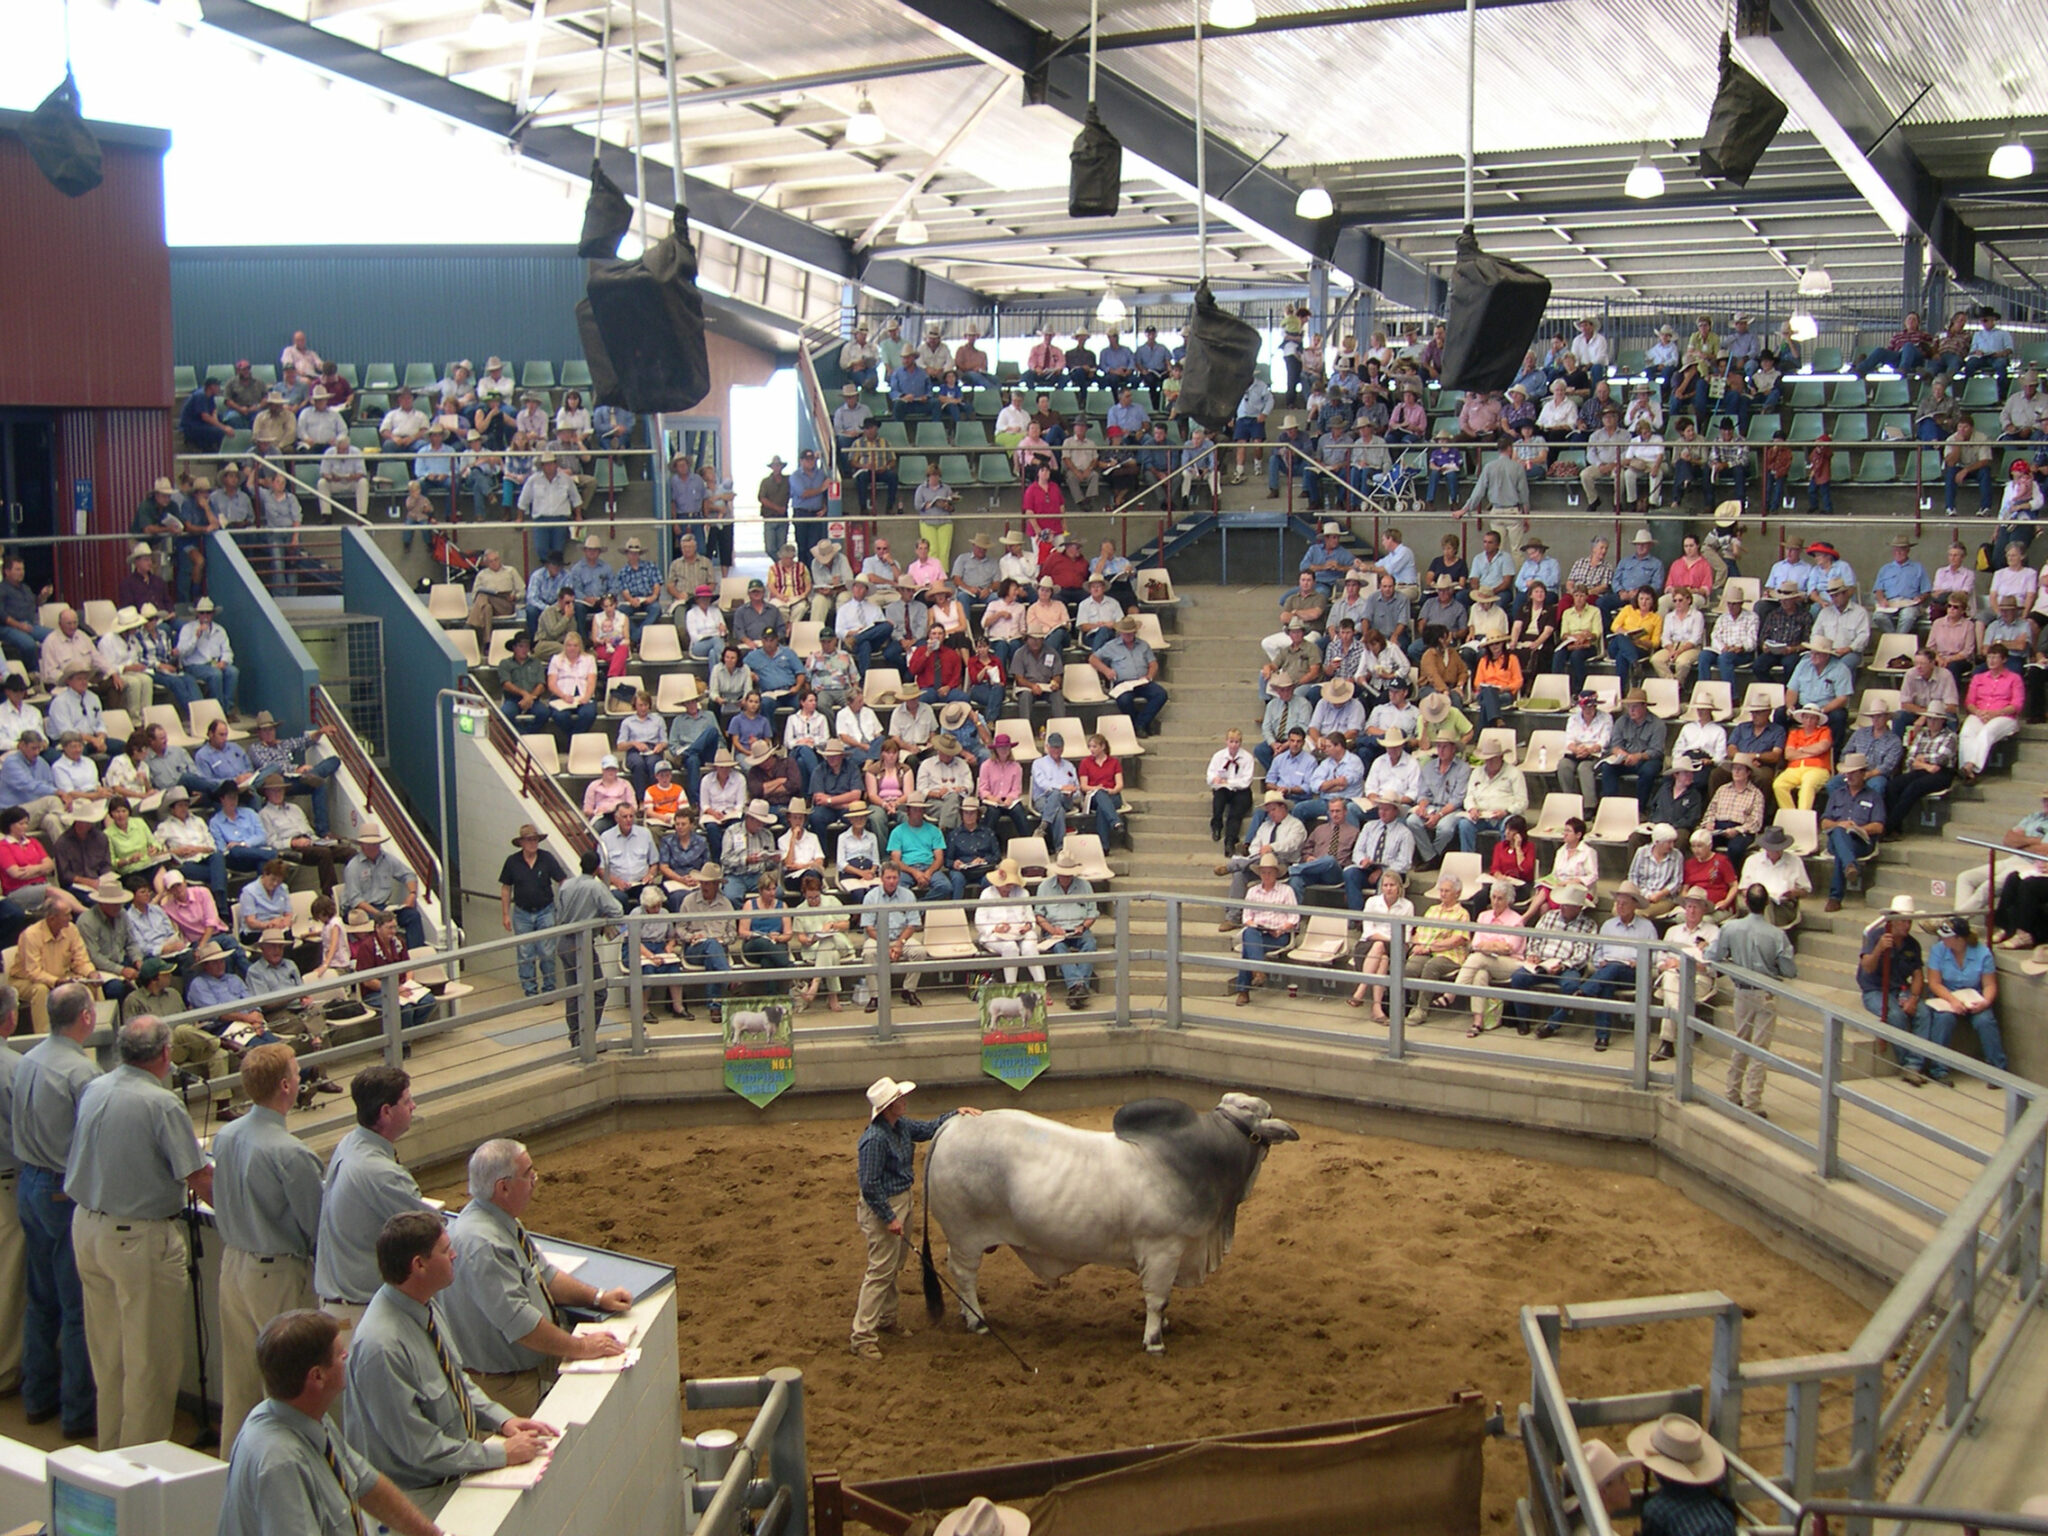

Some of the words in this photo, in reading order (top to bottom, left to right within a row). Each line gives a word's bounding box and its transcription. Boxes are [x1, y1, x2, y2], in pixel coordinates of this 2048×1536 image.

[1027, 1043, 1047, 1055] NO.1
[772, 1058, 792, 1070] NO.1
[992, 1056, 1040, 1069] TROPICAL
[734, 1072, 785, 1084] TROPICAL
[1000, 1068, 1034, 1079] BREED
[743, 1083, 777, 1094] BREED
